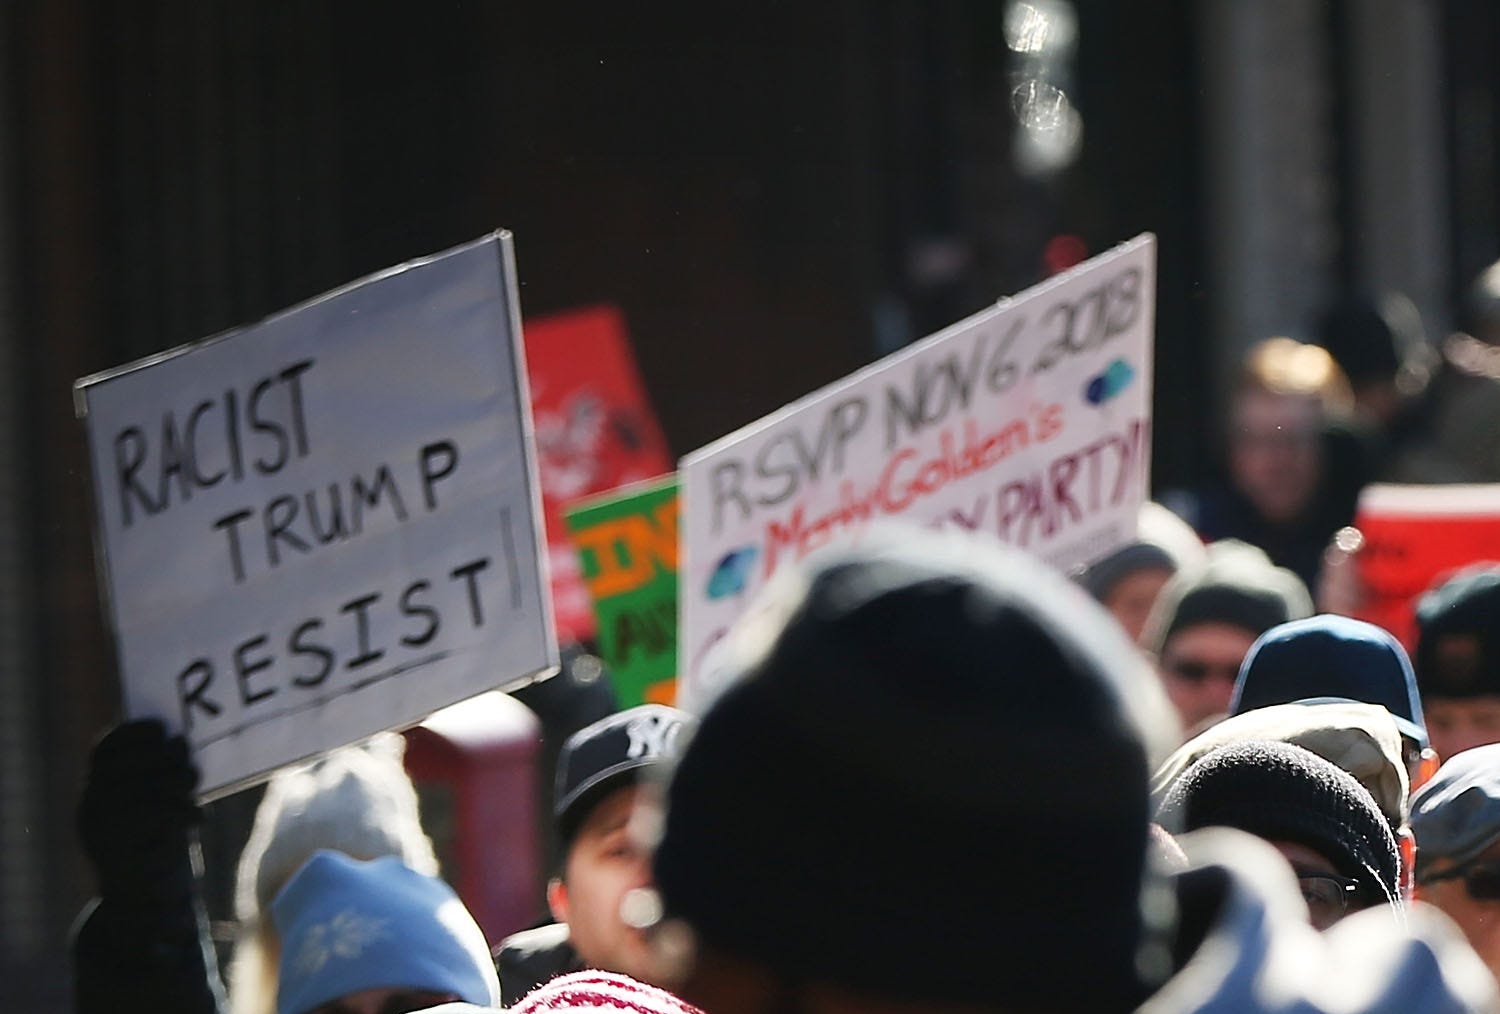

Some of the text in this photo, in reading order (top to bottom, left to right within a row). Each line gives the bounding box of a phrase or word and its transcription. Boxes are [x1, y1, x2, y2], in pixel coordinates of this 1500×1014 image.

[112, 358, 315, 528] RACIST
[212, 440, 460, 584] TRUMP
[710, 396, 868, 538] RSVP
[885, 333, 985, 450] NOV
[175, 557, 492, 730] RESIST
